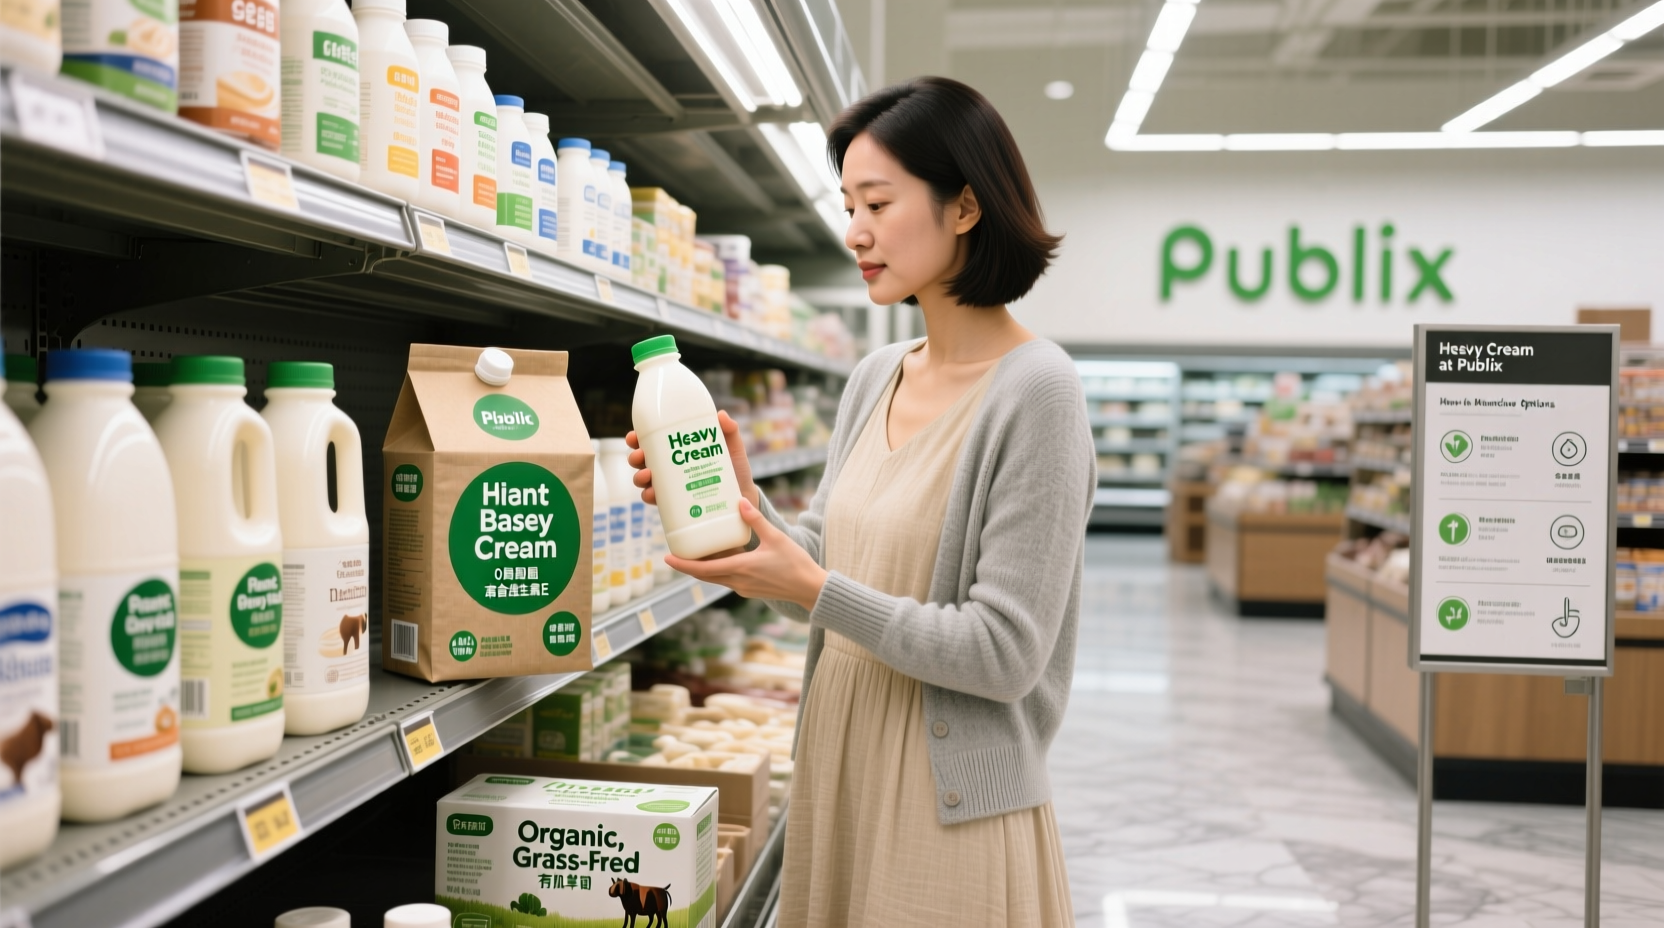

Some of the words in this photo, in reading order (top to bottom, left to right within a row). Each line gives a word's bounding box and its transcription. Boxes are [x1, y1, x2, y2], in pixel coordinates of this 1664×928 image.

[1159, 224, 1455, 303] Publix
[1486, 342, 1534, 357] Cream
[1438, 358, 1453, 372] at
[1457, 357, 1503, 373] Publix
[667, 426, 717, 450] Heavy
[671, 443, 724, 466] Cream
[482, 482, 550, 507] Hiant
[479, 508, 554, 538] Basey
[474, 534, 557, 560] Cream
[517, 819, 625, 853] Organic,
[512, 845, 640, 874] Grass-Fred
